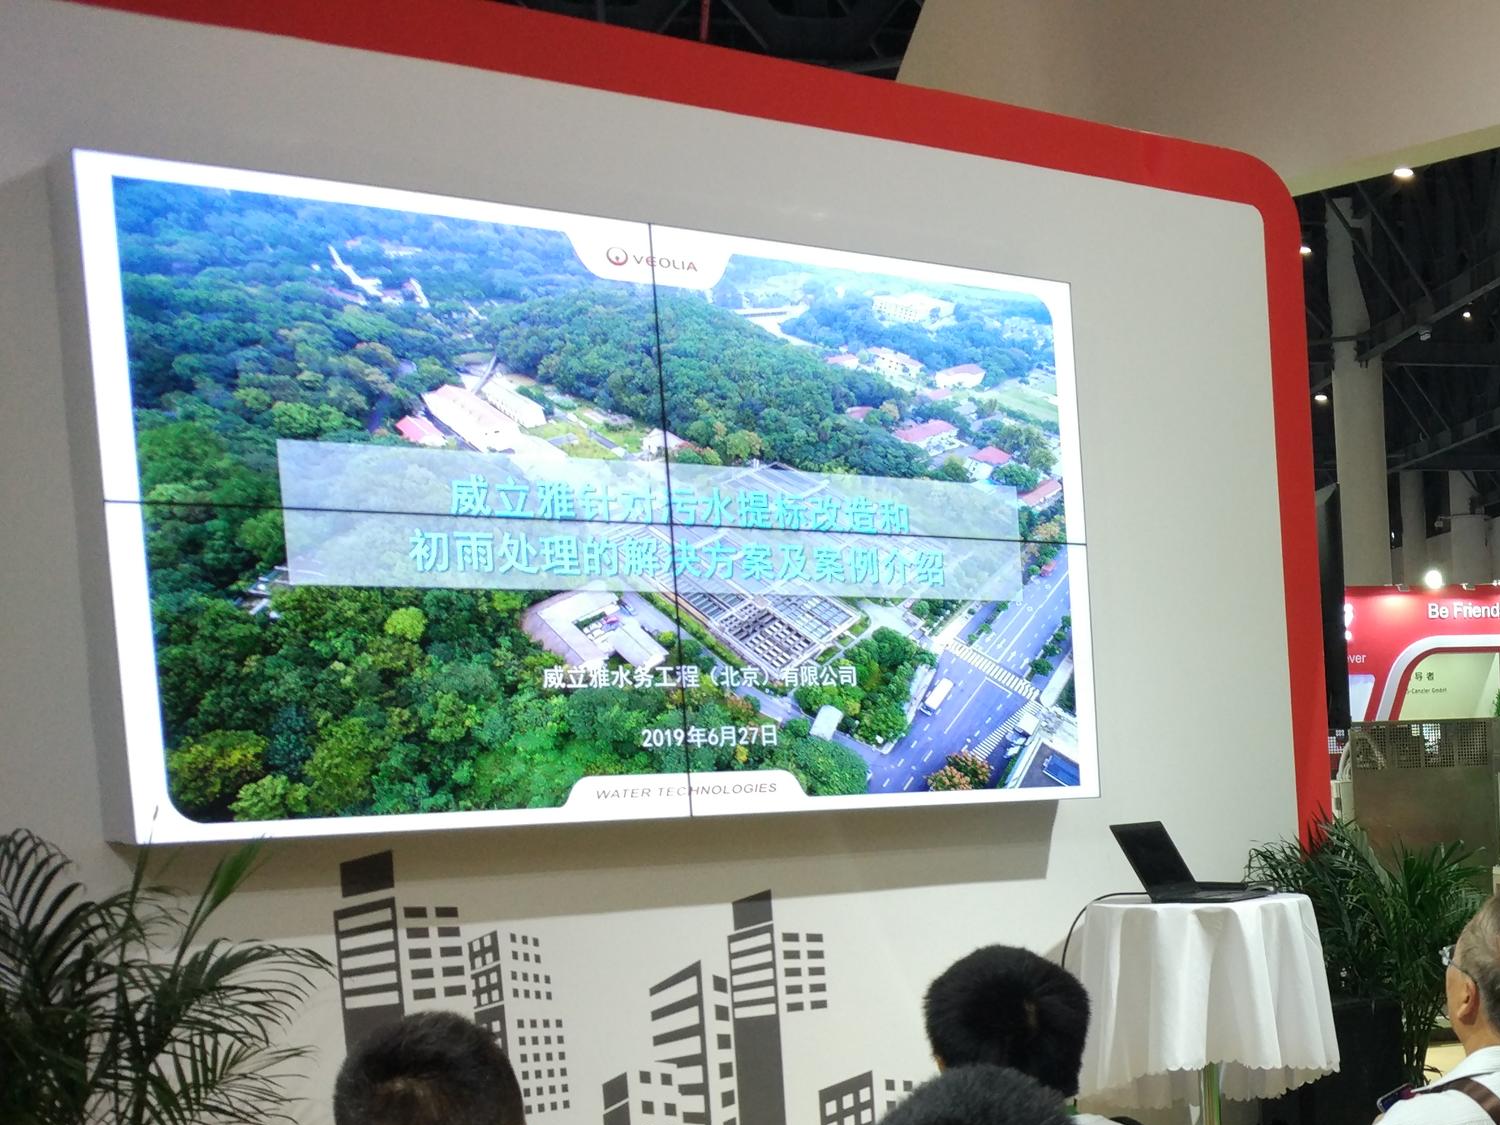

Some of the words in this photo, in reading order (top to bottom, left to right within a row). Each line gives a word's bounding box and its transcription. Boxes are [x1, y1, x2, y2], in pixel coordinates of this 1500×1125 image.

[633, 254, 698, 272] VEOLIA
[450, 474, 911, 535] 威立雅针对污水提标改造和
[409, 528, 945, 587] 初雨处理的解决方案及案例介绍
[1427, 602, 1449, 619] Be
[543, 665, 858, 689] 威立雅水务工程（北京）有限公司
[641, 725, 778, 748] 2019年6月27日
[596, 787, 650, 800] WATER
[658, 783, 777, 797] TECHNOLOGIES
